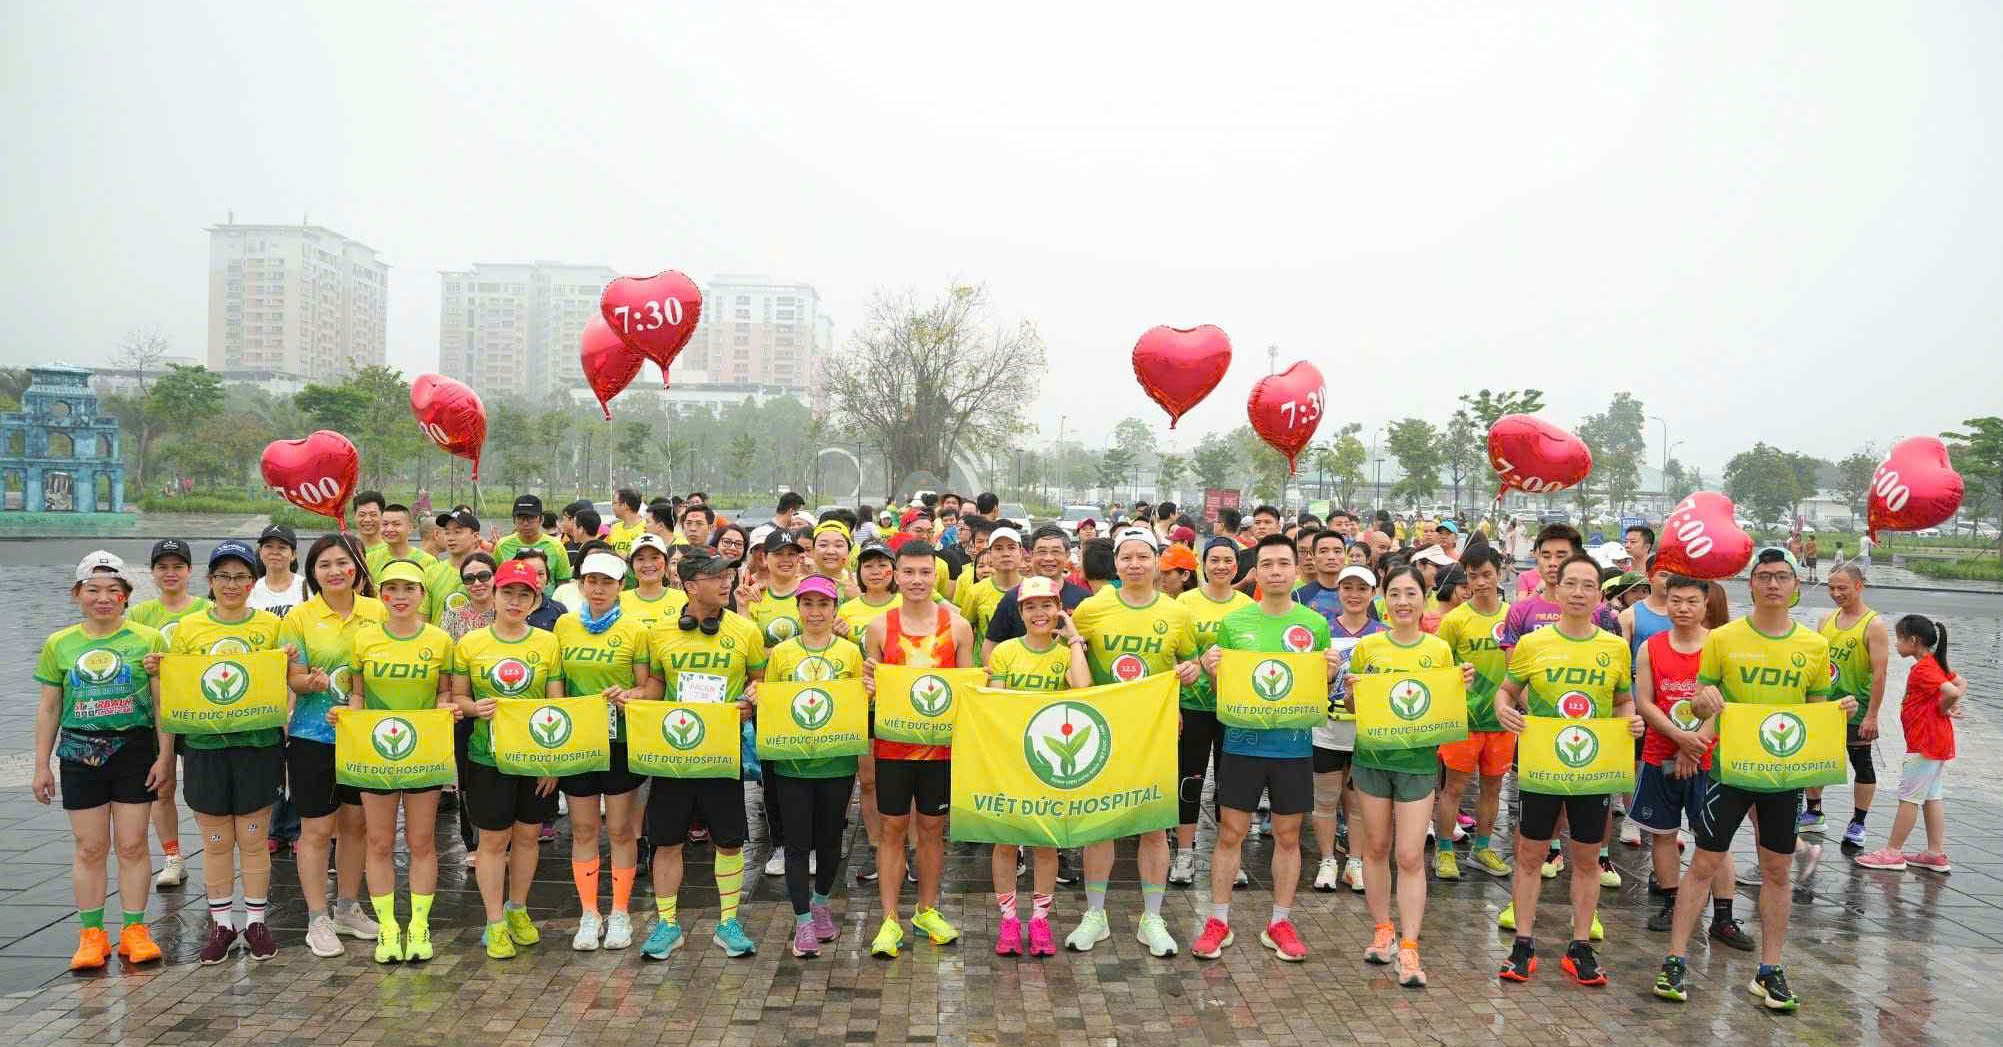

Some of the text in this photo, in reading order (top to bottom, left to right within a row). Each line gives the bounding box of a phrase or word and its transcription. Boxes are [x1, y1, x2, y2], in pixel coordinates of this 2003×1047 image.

[614, 296, 683, 334] 7:30
[1671, 498, 1713, 559] 7:00
[1104, 635, 1164, 654] VDH
[562, 647, 616, 662] VDH
[670, 652, 731, 668] VDH
[373, 661, 430, 678] VDH
[1546, 667, 1606, 685] VDH
[1739, 666, 1801, 688] VDH
[1009, 673, 1062, 690] VDH
[225, 704, 280, 718] HOSPITAL
[1274, 705, 1321, 715] HOSPITAL
[1412, 721, 1461, 733] HOSPITAL
[812, 730, 863, 744] HOSPITAL
[553, 748, 602, 762] HOSPITAL
[684, 755, 734, 765] HOSPITAL
[394, 764, 449, 775] HOSPITAL
[1783, 760, 1839, 773] HOSPITAL
[1576, 771, 1626, 782] HOSPITAL
[973, 784, 1162, 818] VIỆT ĐỨC HOSPITAL
